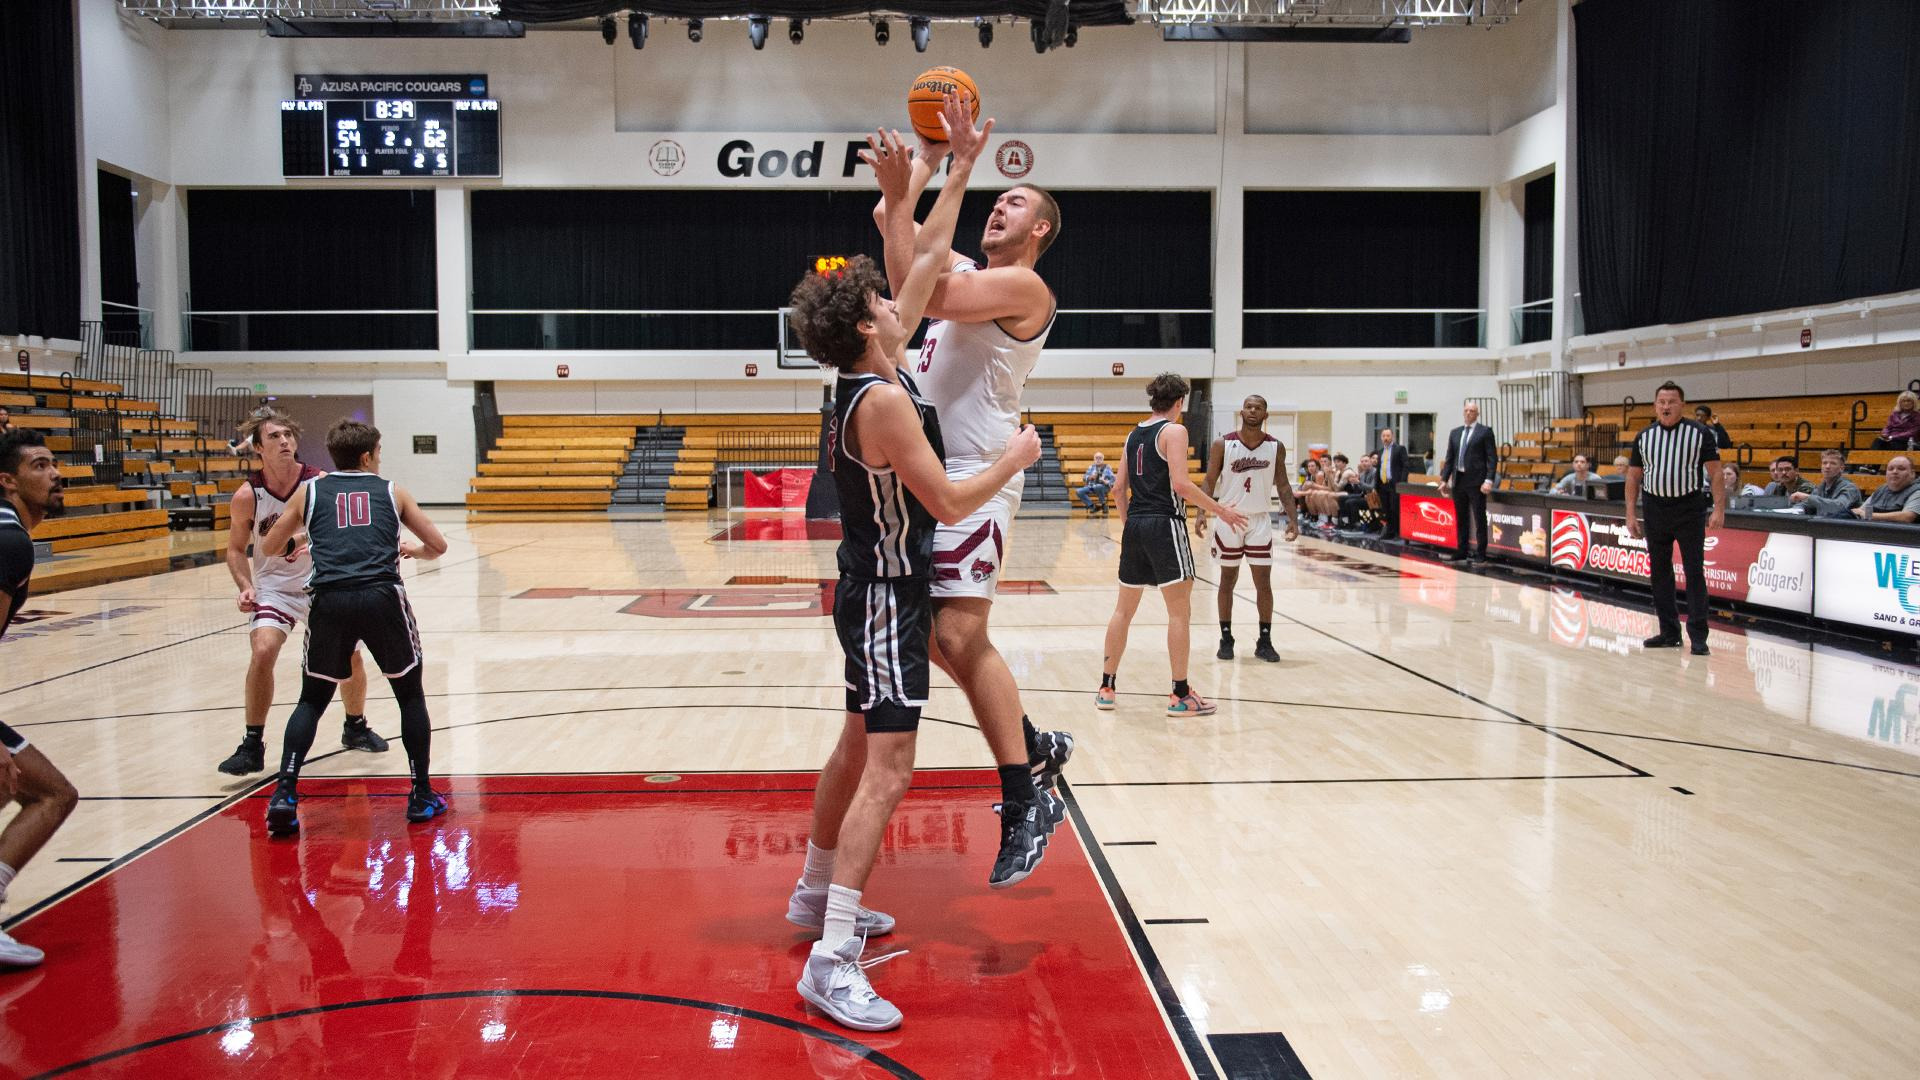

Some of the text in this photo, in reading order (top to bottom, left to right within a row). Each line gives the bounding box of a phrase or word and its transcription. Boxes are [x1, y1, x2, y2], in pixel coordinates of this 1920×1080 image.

[320, 82, 359, 92] AZUSA
[361, 82, 403, 92] PACIFIC
[405, 82, 461, 92] COUGARS
[375, 100, 414, 119] 8:39
[337, 130, 361, 147] 54
[384, 131, 396, 146] 2
[423, 130, 447, 147] 62
[414, 153, 425, 168] 2
[717, 139, 825, 178] God
[1136, 443, 1144, 476] 1
[1243, 477, 1252, 493] 4
[335, 491, 372, 529] 10
[1589, 544, 1652, 578] COUGARS
[1760, 551, 1776, 571] Go
[1749, 565, 1804, 593] Cougars!
[1873, 612, 1898, 623] SAND
[1899, 616, 1906, 625] &
